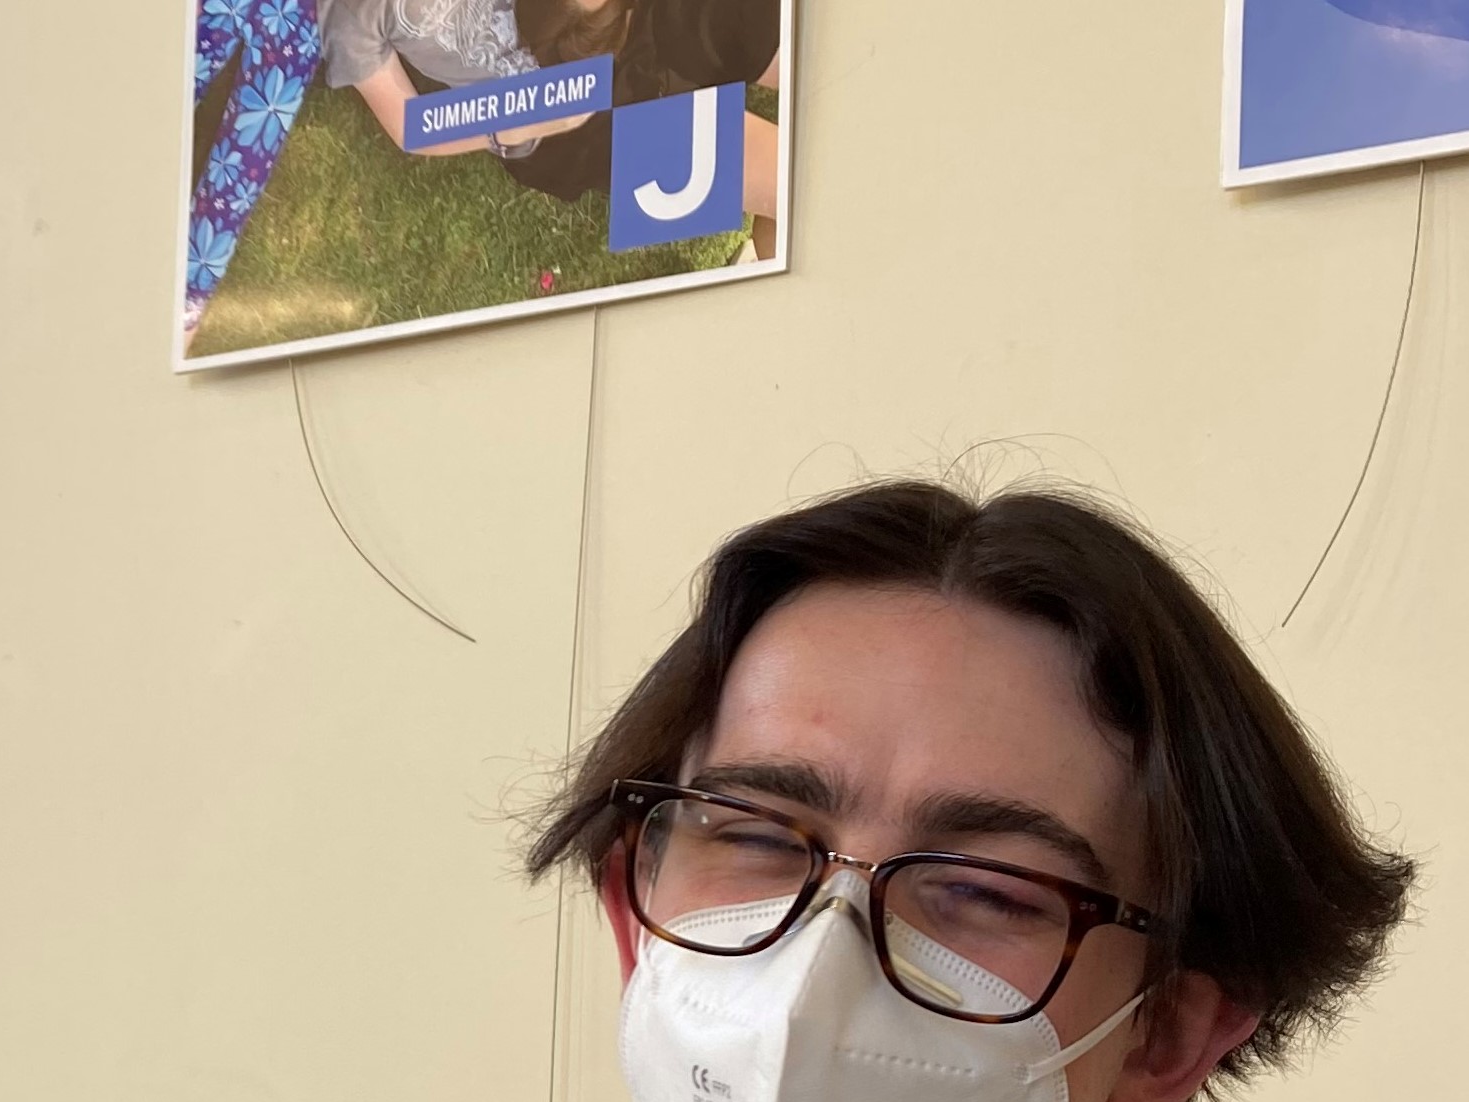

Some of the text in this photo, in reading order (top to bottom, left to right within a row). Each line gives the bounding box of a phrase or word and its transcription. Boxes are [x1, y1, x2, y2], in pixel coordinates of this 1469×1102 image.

[421, 73, 597, 134] SUMMER DAY CAMP
[633, 86, 718, 221] J
